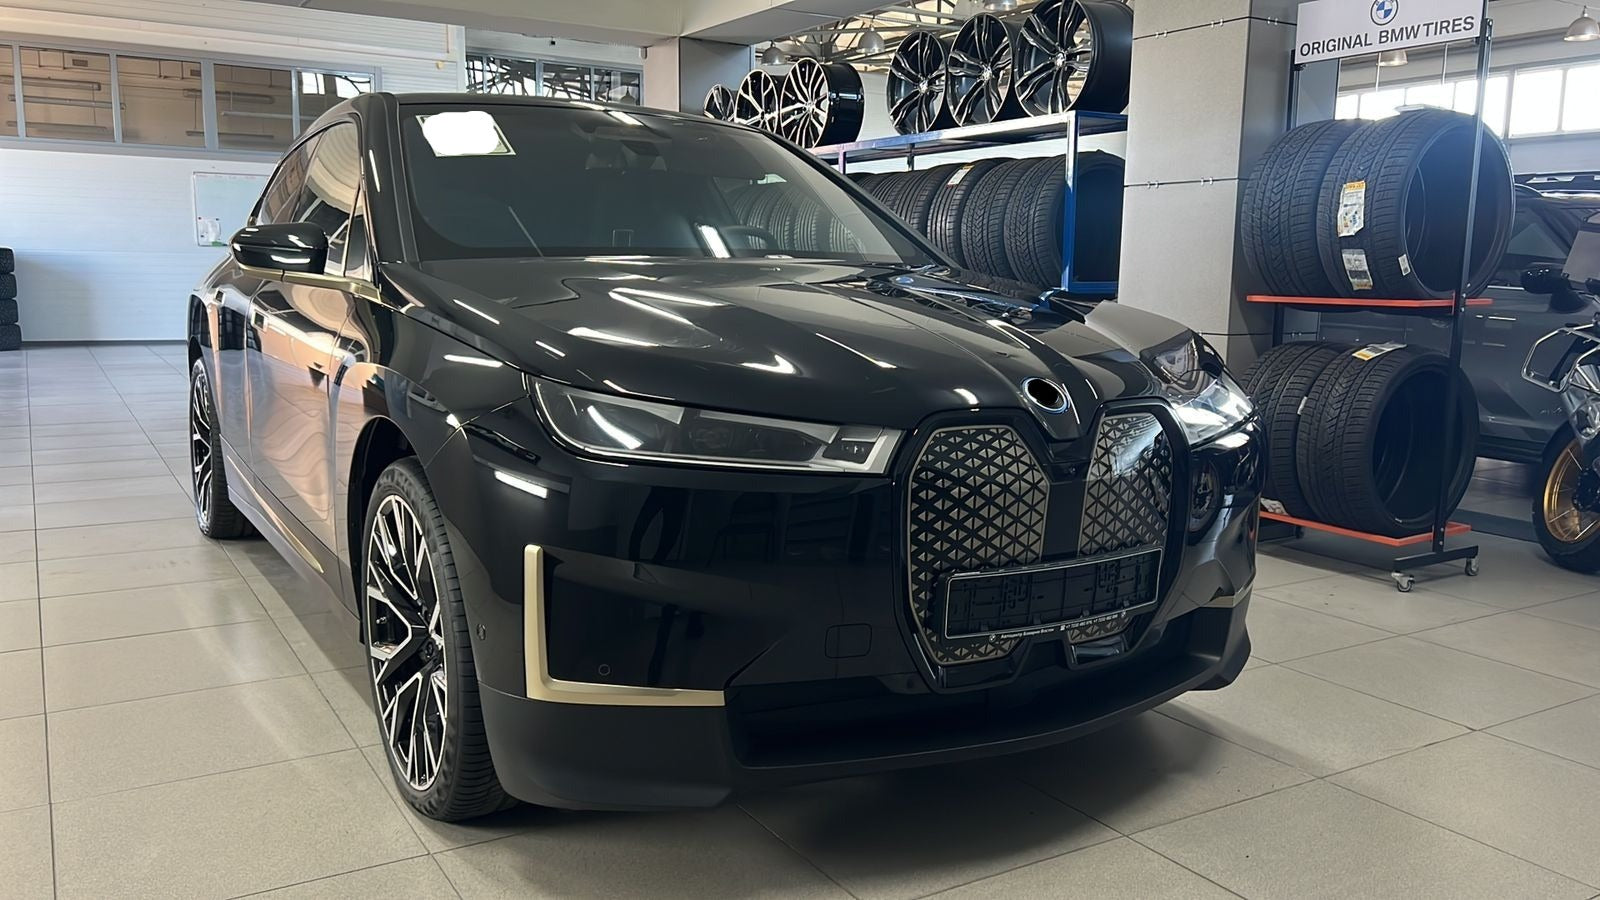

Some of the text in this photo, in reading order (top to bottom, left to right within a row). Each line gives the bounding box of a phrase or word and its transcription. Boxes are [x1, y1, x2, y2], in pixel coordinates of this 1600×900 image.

[1300, 16, 1475, 56] ORIGINAL BMW TIRES
